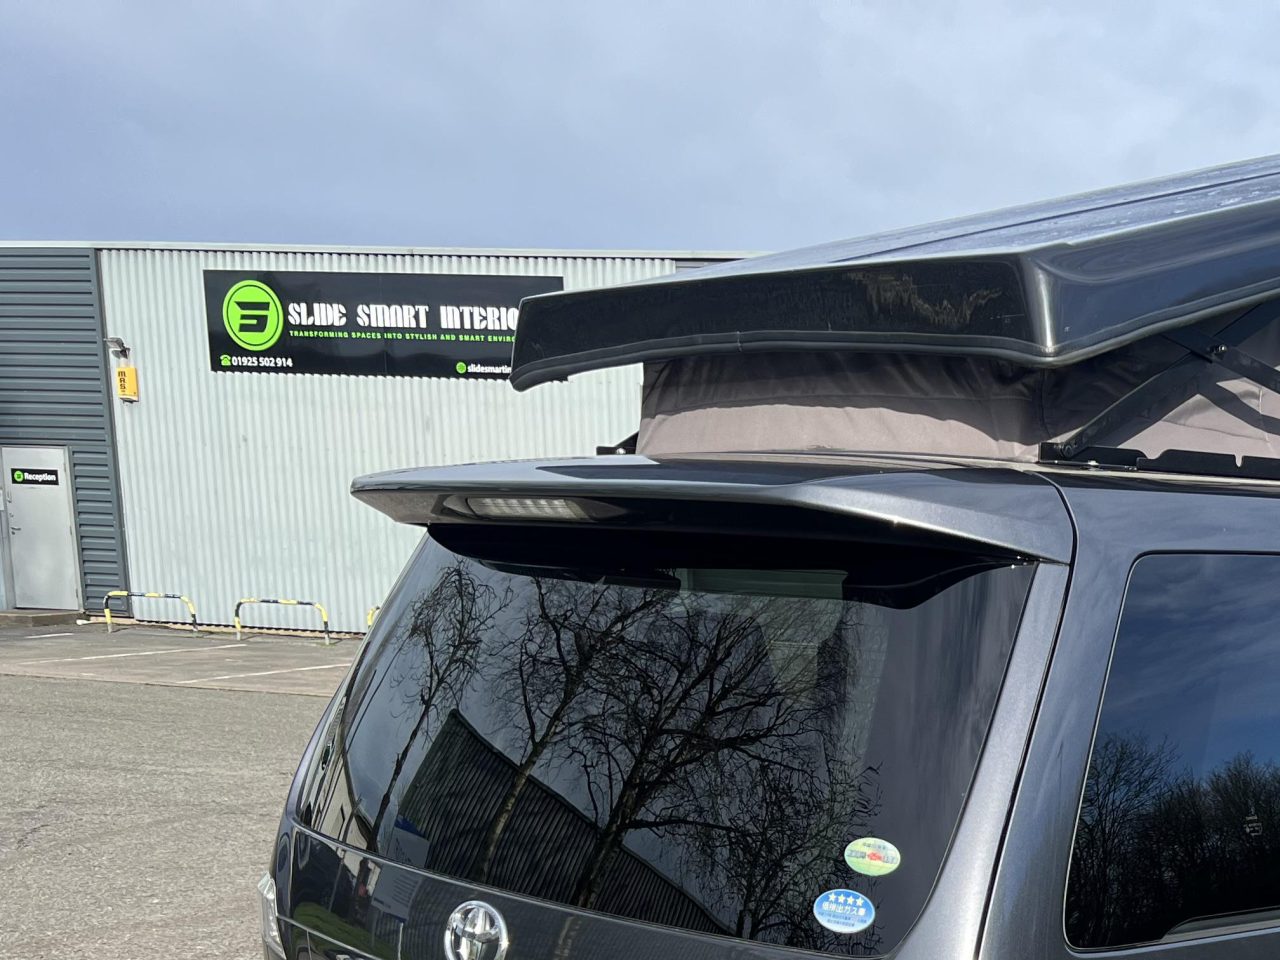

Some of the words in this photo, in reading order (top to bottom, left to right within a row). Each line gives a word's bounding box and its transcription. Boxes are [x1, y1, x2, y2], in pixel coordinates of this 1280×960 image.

[288, 302, 347, 326] SLIDE
[356, 304, 429, 328] SMART
[289, 330, 348, 338] TRANSFORMING
[231, 356, 258, 366] 01925
[259, 357, 276, 367] 502
[276, 358, 293, 367] 914
[24, 471, 56, 482] Reception
